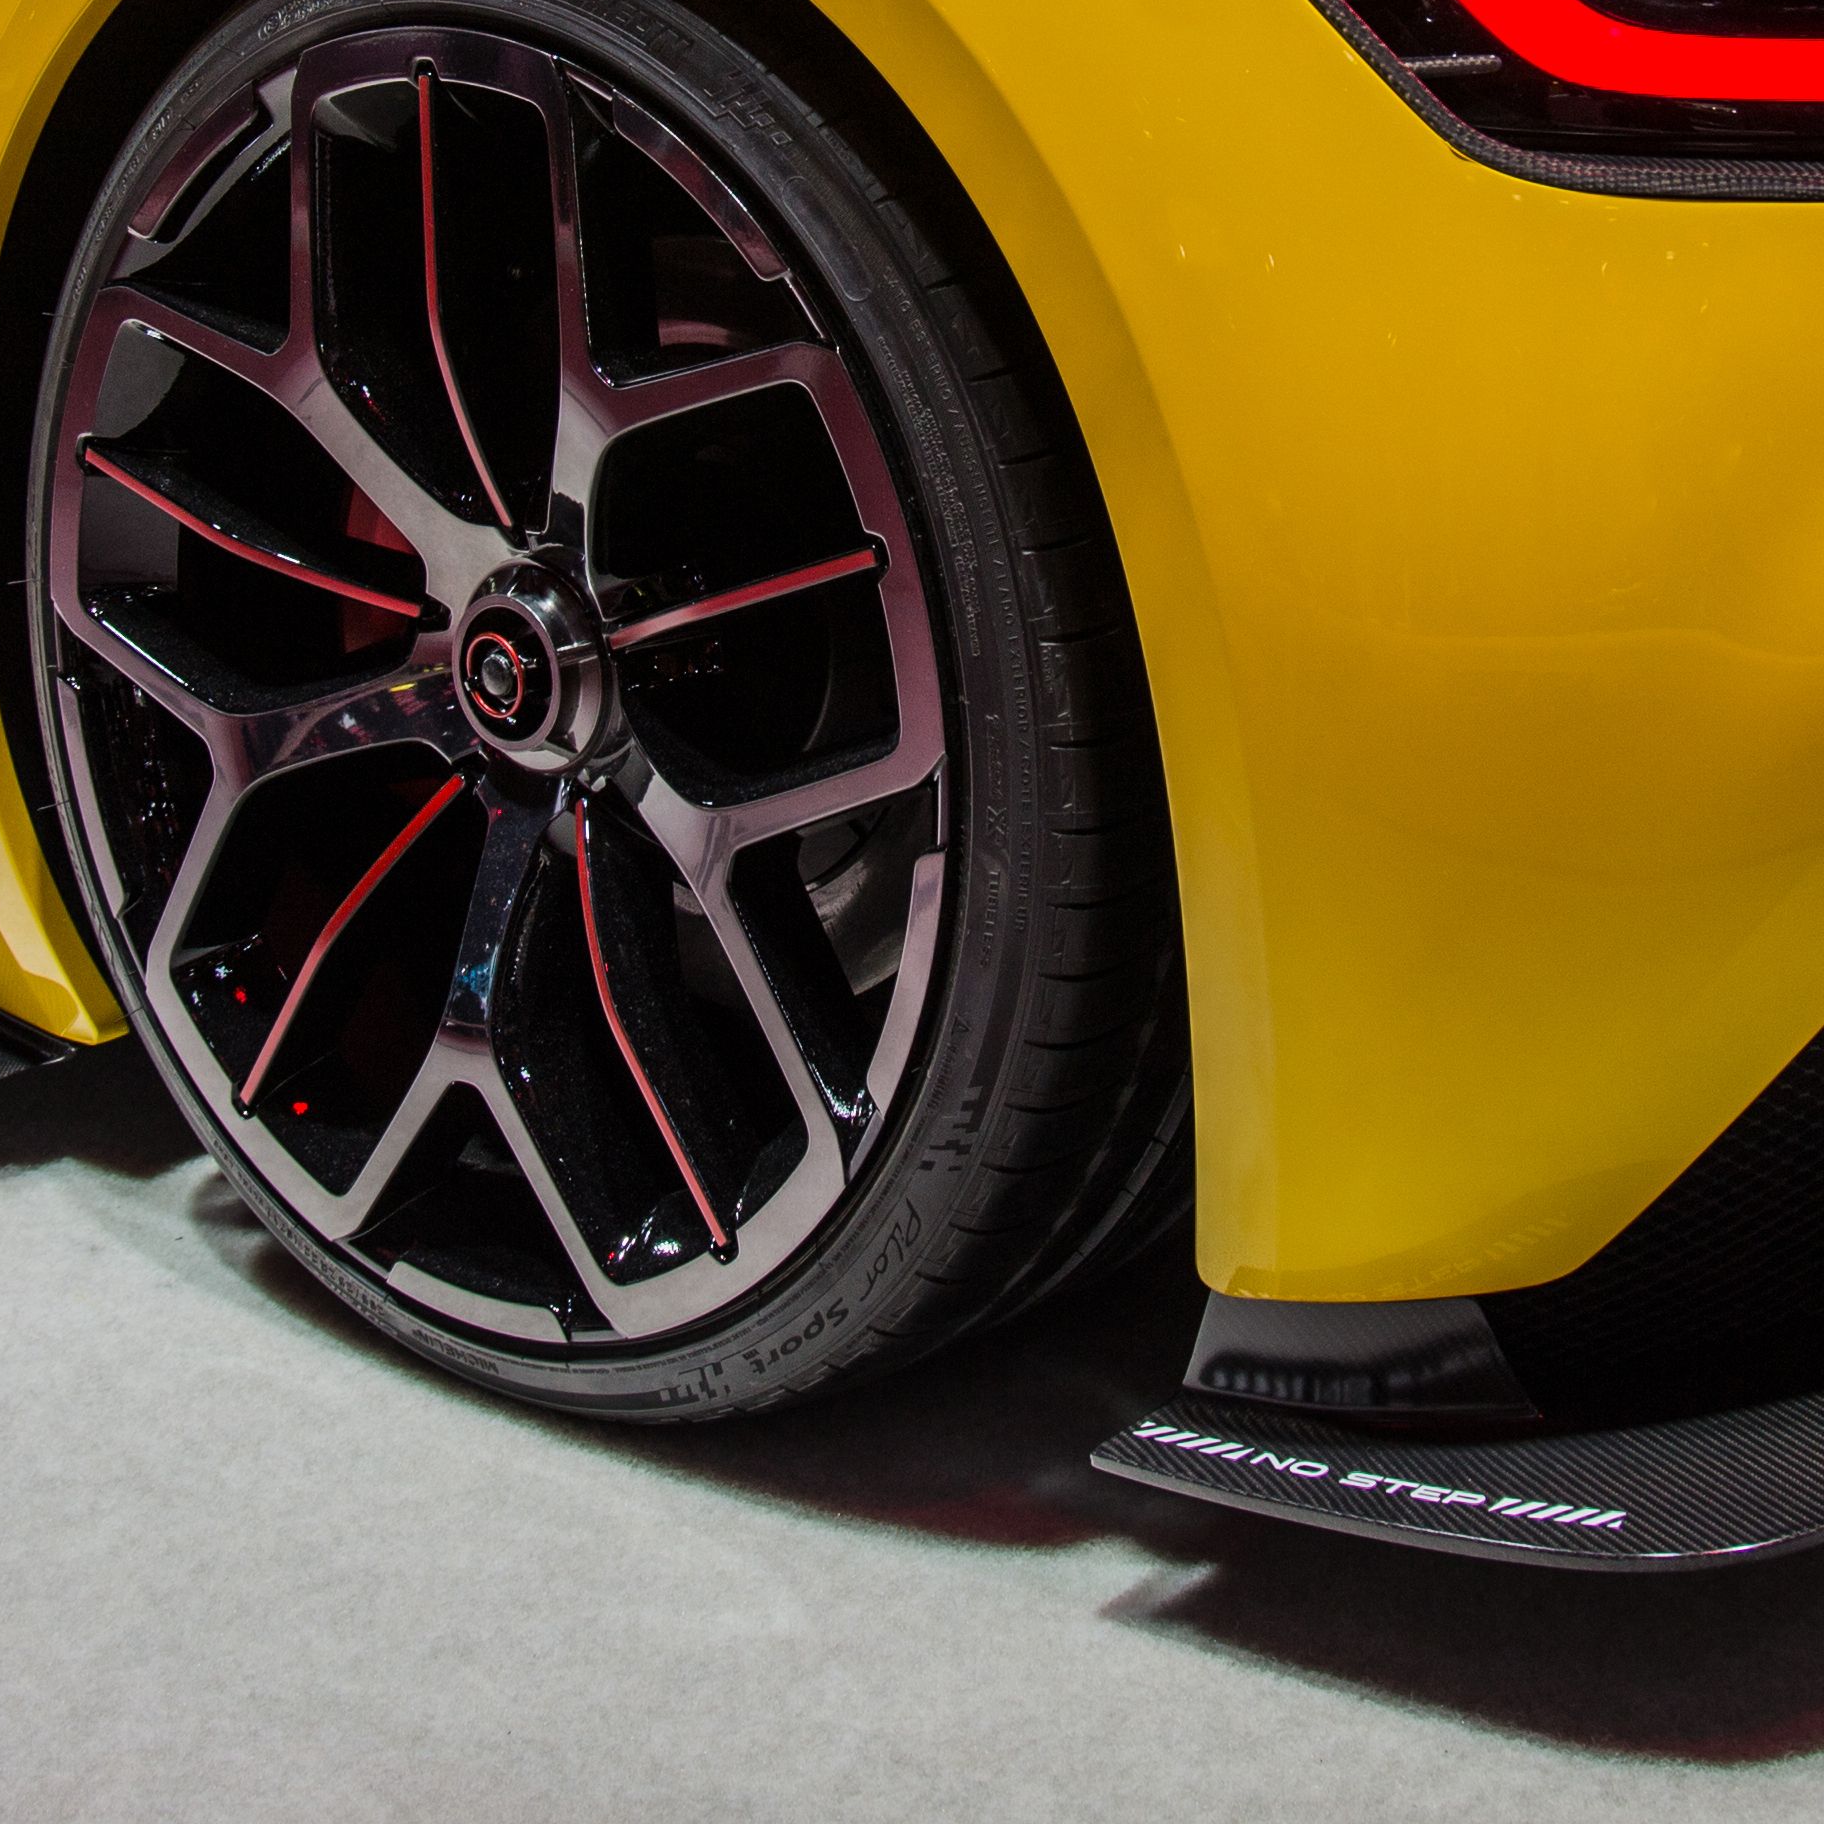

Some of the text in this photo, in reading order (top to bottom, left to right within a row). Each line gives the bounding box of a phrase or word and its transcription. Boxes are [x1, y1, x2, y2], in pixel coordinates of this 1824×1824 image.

[748, 1296, 851, 1376] Sport
[1249, 1452, 1487, 1506] NO STEP
